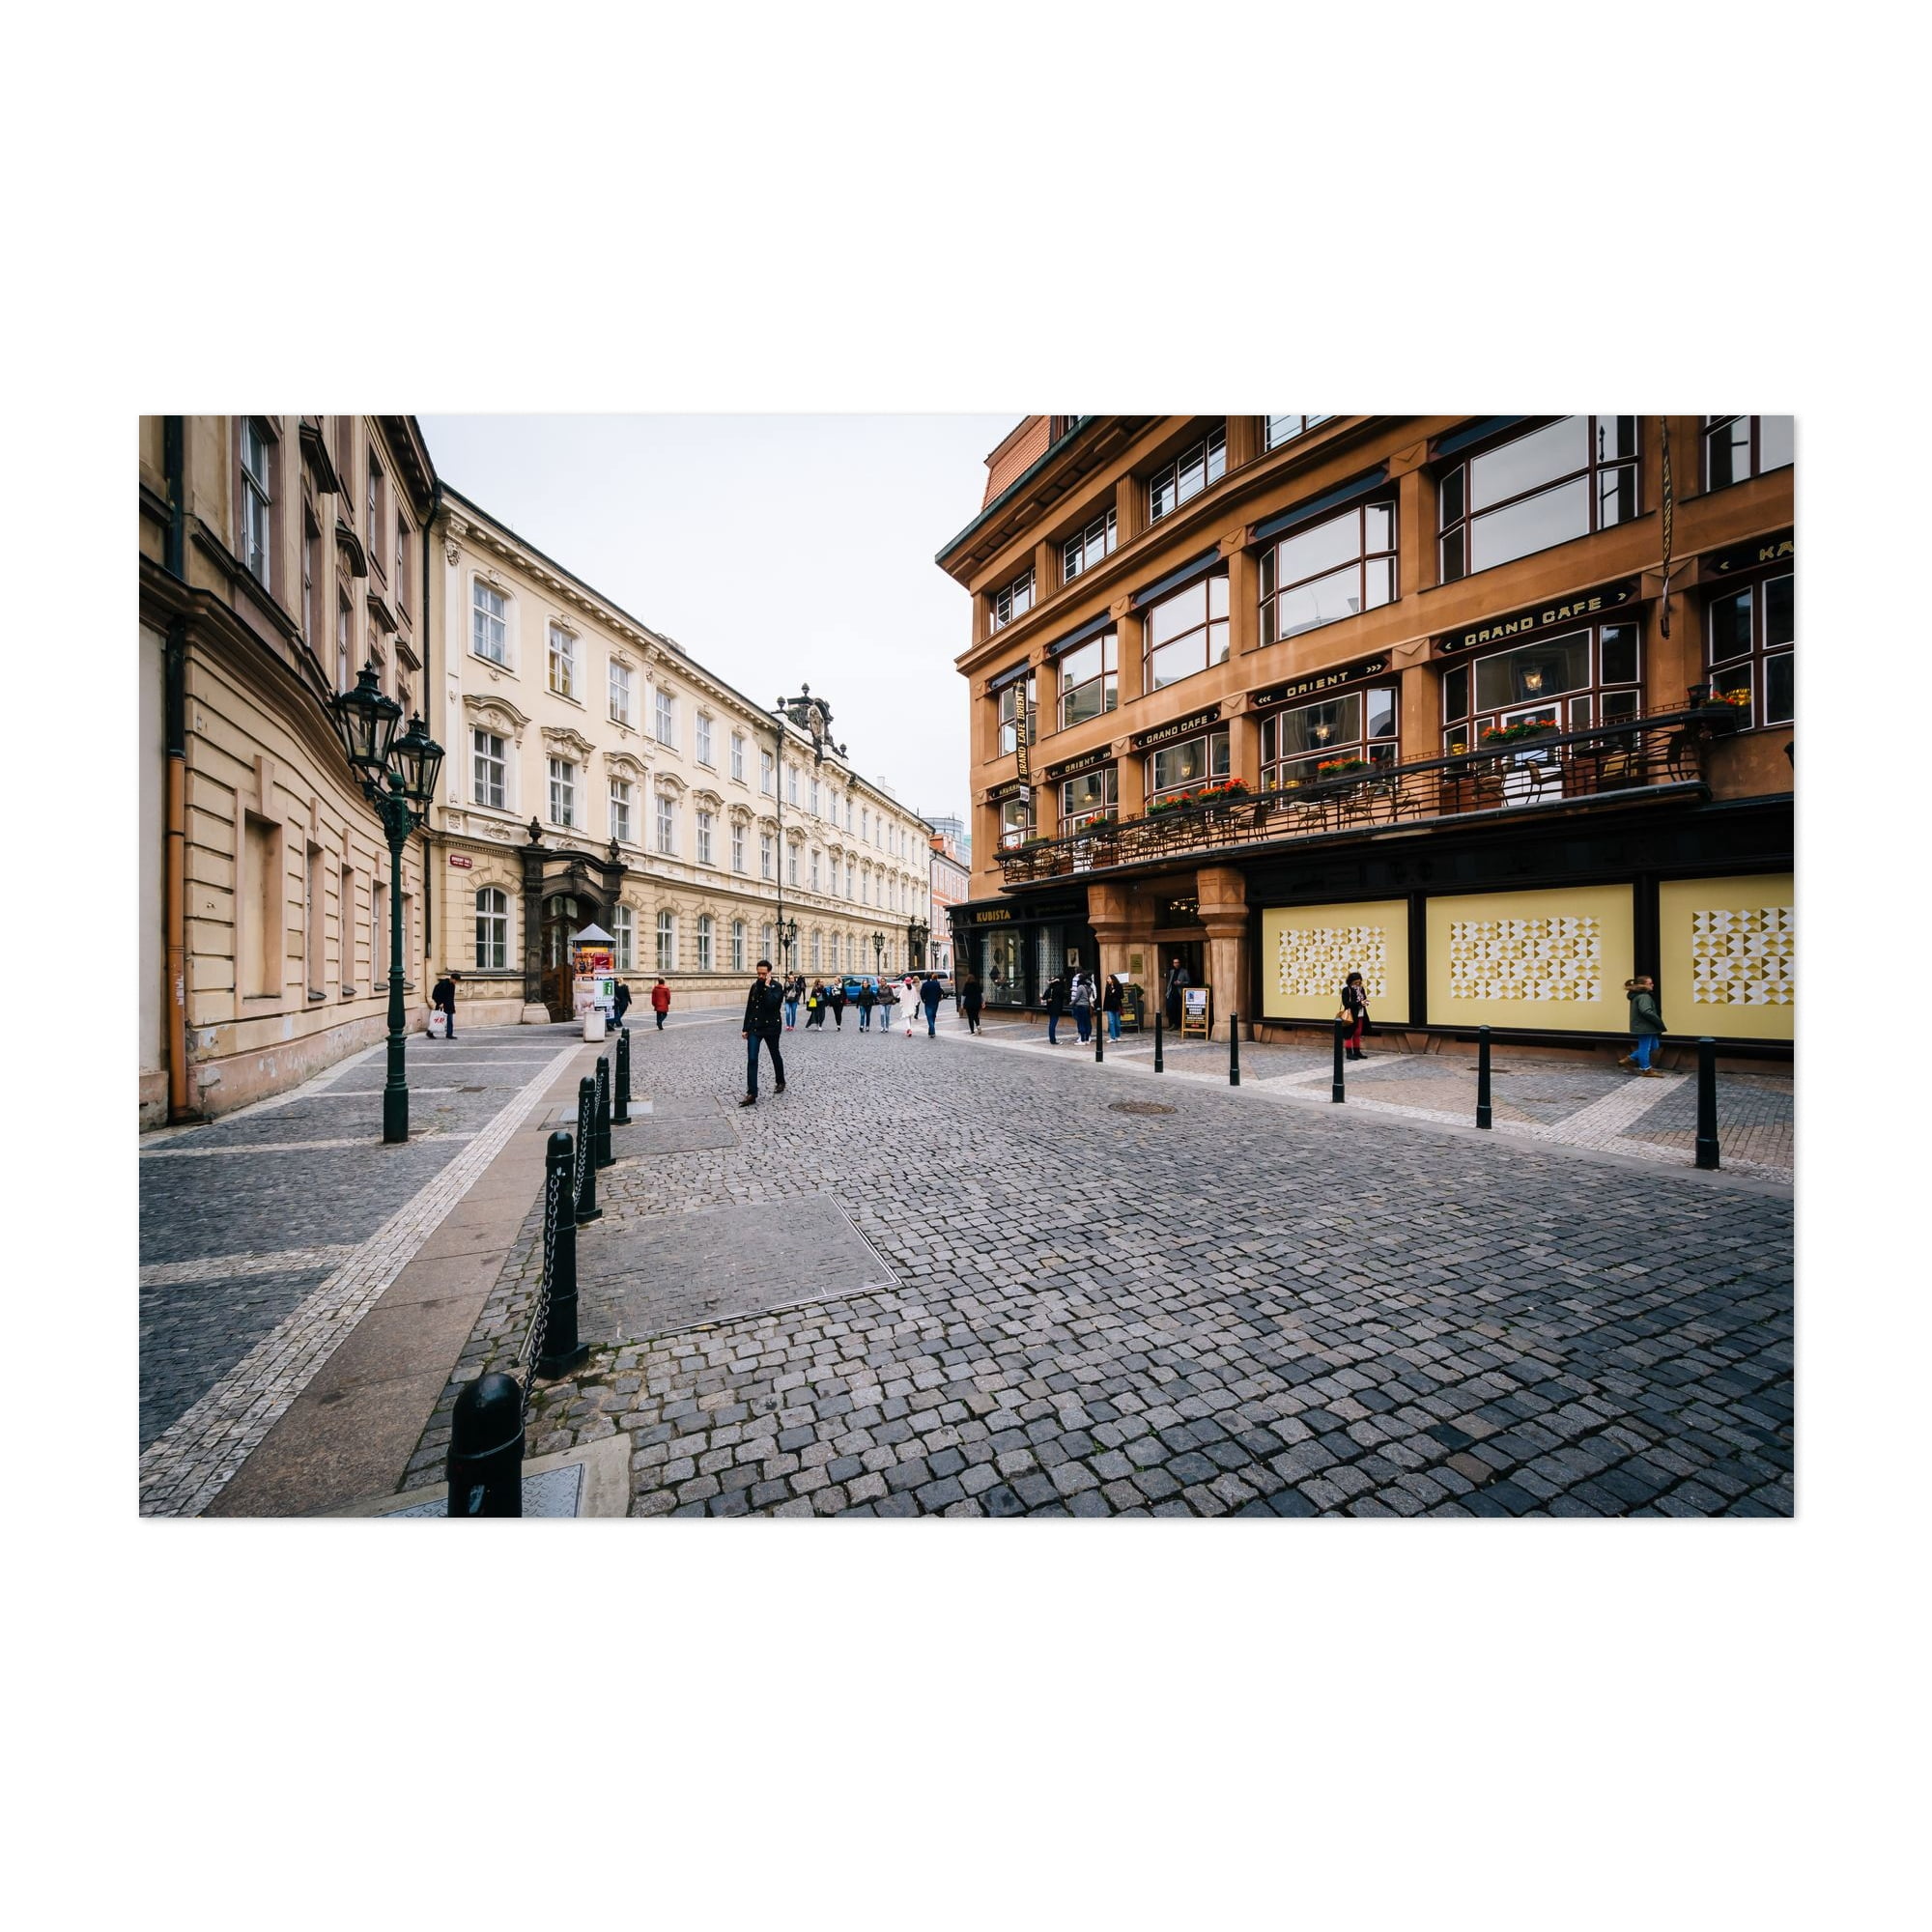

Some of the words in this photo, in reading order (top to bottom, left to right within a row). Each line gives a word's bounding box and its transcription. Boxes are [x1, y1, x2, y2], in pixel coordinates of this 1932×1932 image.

[1759, 541, 1794, 561] KA
[1464, 616, 1533, 646] GRAND
[1542, 597, 1602, 624] CAFE
[1287, 671, 1349, 696] ORIENT
[1015, 691, 1025, 720] ORIENT
[1017, 723, 1026, 744] CAFE
[1146, 725, 1179, 744] GRAND
[1180, 715, 1208, 731] CAFE
[1019, 746, 1028, 776] GRAND
[1065, 756, 1095, 773] ORIENT
[976, 909, 1011, 923] KUBISTA
